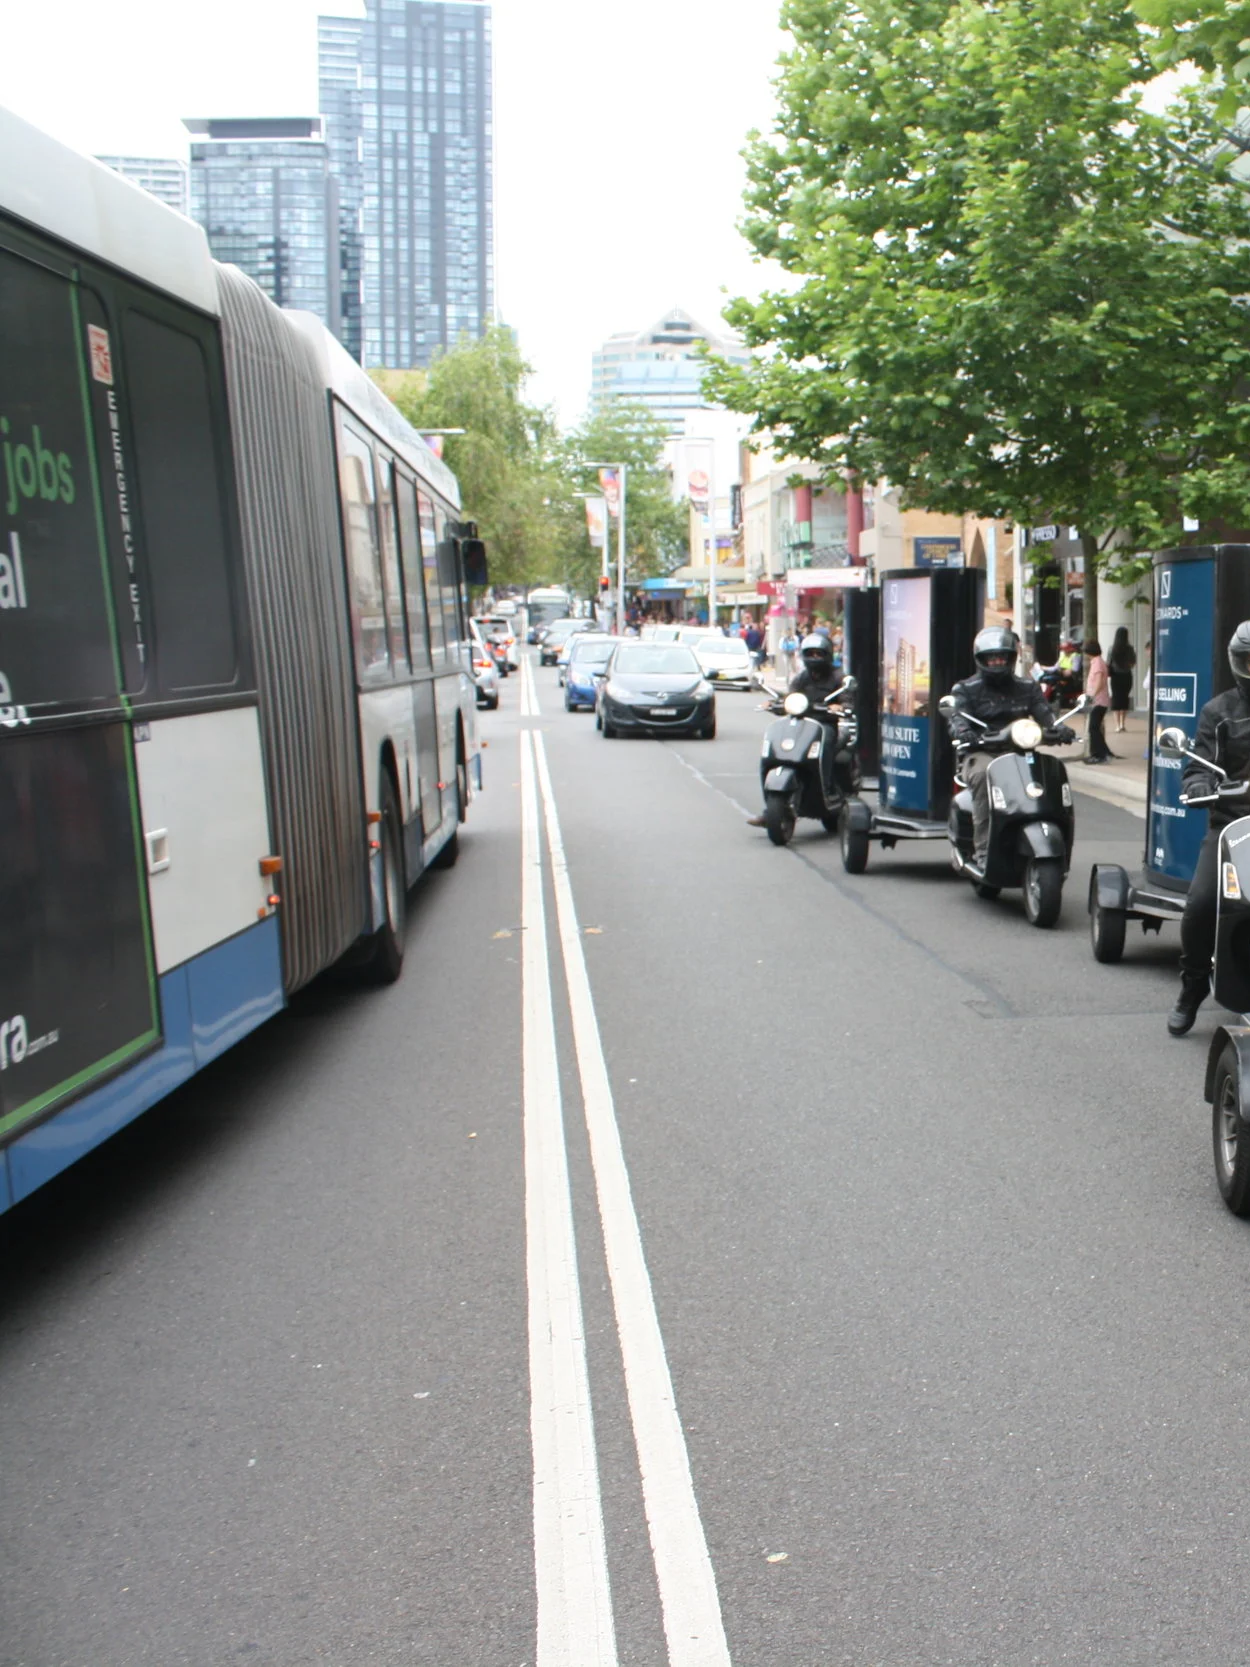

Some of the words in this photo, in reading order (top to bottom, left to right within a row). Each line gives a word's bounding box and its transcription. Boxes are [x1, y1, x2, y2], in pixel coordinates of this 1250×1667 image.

[0, 416, 76, 516] jobs
[107, 390, 135, 574] EMERGENCY
[129, 583, 145, 664] EXIT
[1159, 687, 1187, 702] SELLING
